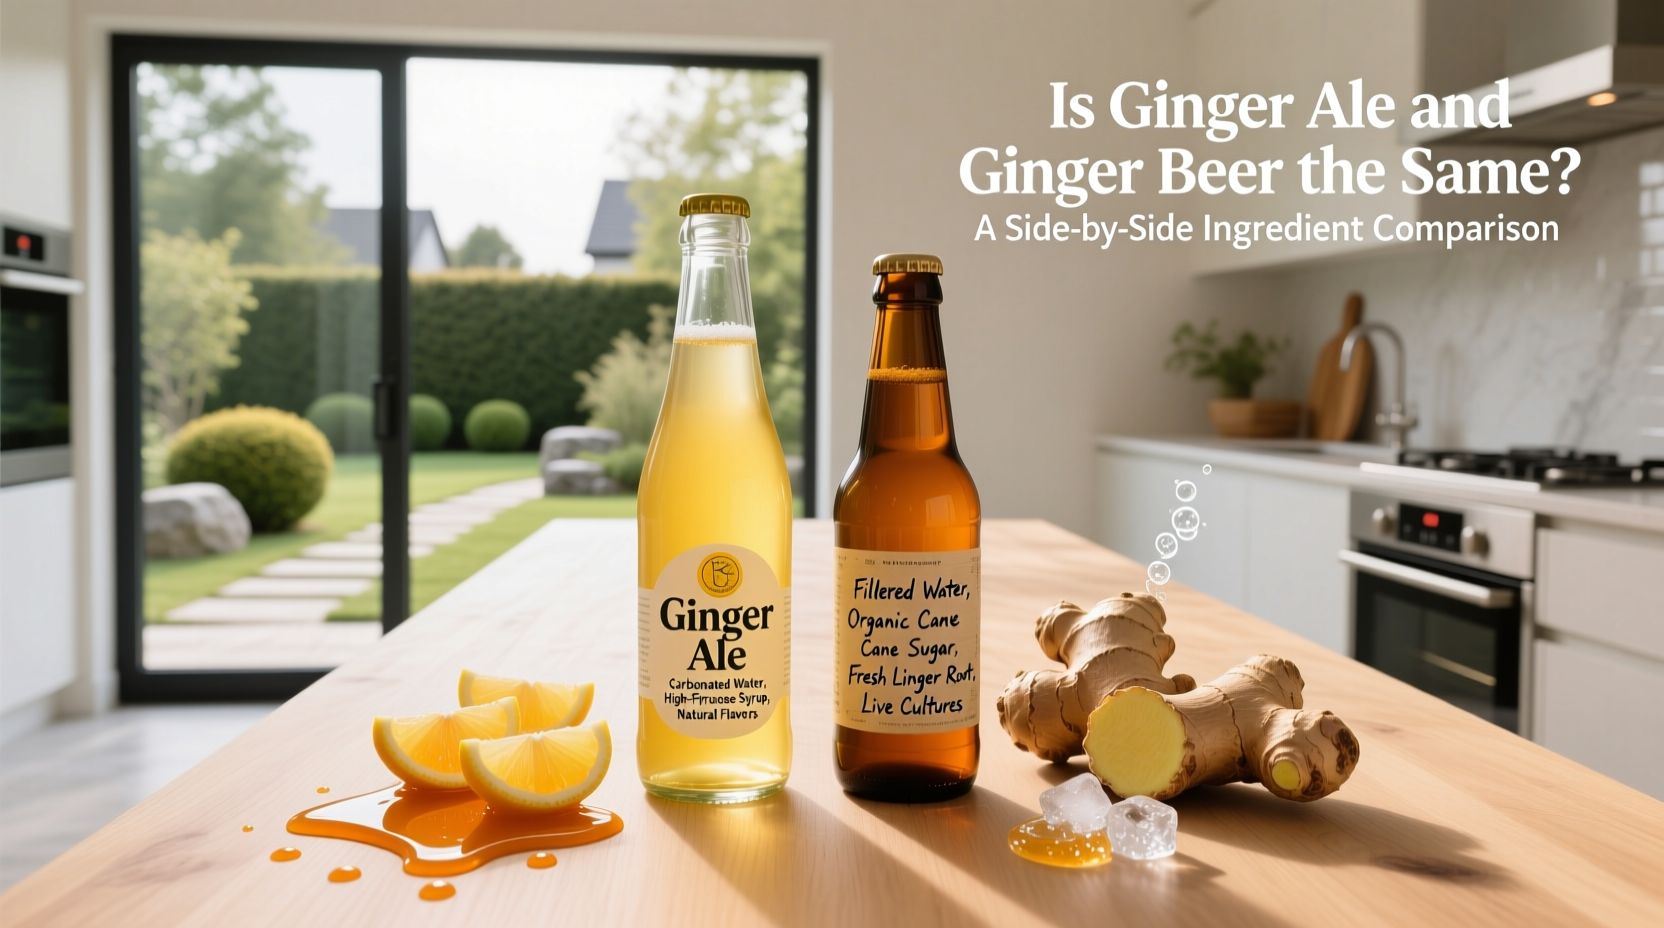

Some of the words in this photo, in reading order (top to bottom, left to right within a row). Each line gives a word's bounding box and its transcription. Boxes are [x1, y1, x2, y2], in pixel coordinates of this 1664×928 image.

[923, 577, 970, 601] Water,
[660, 597, 774, 642] Ginger
[847, 607, 910, 638] Organic
[917, 608, 960, 630] Cane
[687, 638, 747, 671] Ale
[860, 638, 900, 657] Cane
[907, 637, 959, 665] Sugar,
[668, 677, 731, 691] Carbonated
[848, 663, 887, 686] Fresh
[892, 666, 942, 695] Linger
[677, 708, 718, 721] Natural
[720, 708, 759, 721] Flavors
[861, 691, 895, 715] Live
[900, 694, 964, 716] Cultures
